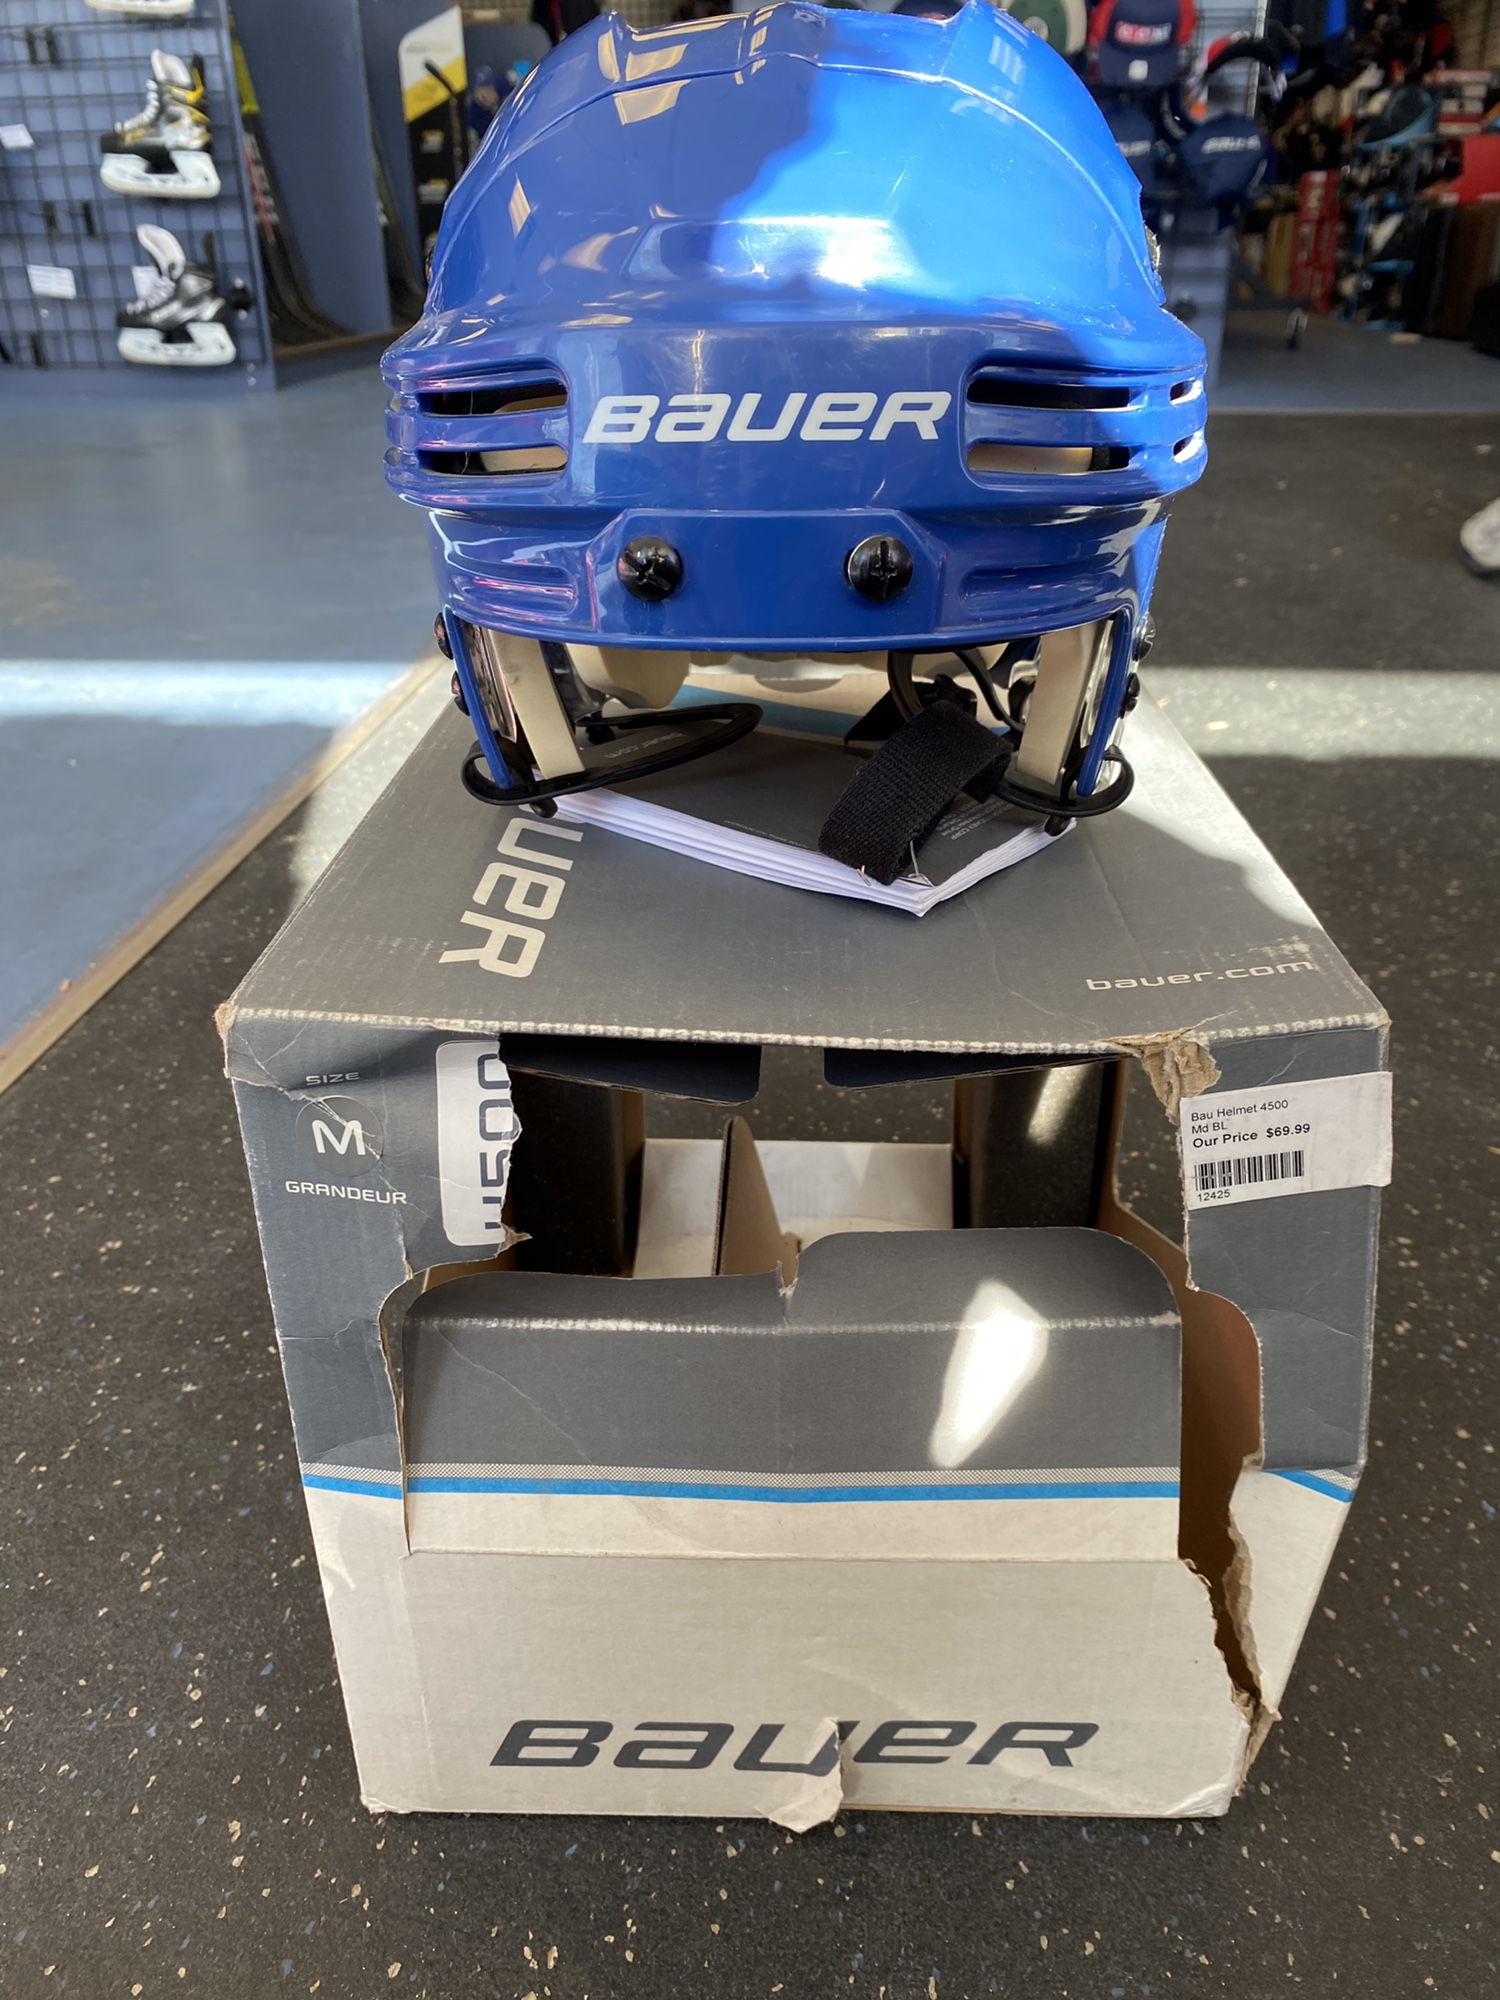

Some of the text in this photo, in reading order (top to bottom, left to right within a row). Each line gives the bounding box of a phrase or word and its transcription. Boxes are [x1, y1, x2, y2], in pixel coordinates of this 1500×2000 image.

[438, 804, 587, 978] UER
[1086, 961, 1315, 991] bauer.com
[305, 1071, 360, 1086] SIZE
[1191, 1100, 1289, 1122] Bau Helmet 4500
[311, 1119, 367, 1155] M
[1191, 1122, 1228, 1135] Md BL
[1192, 1123, 1311, 1149] Our Price $69.99
[285, 1180, 407, 1205] GRANDEUR
[1197, 1189, 1231, 1202] 12425
